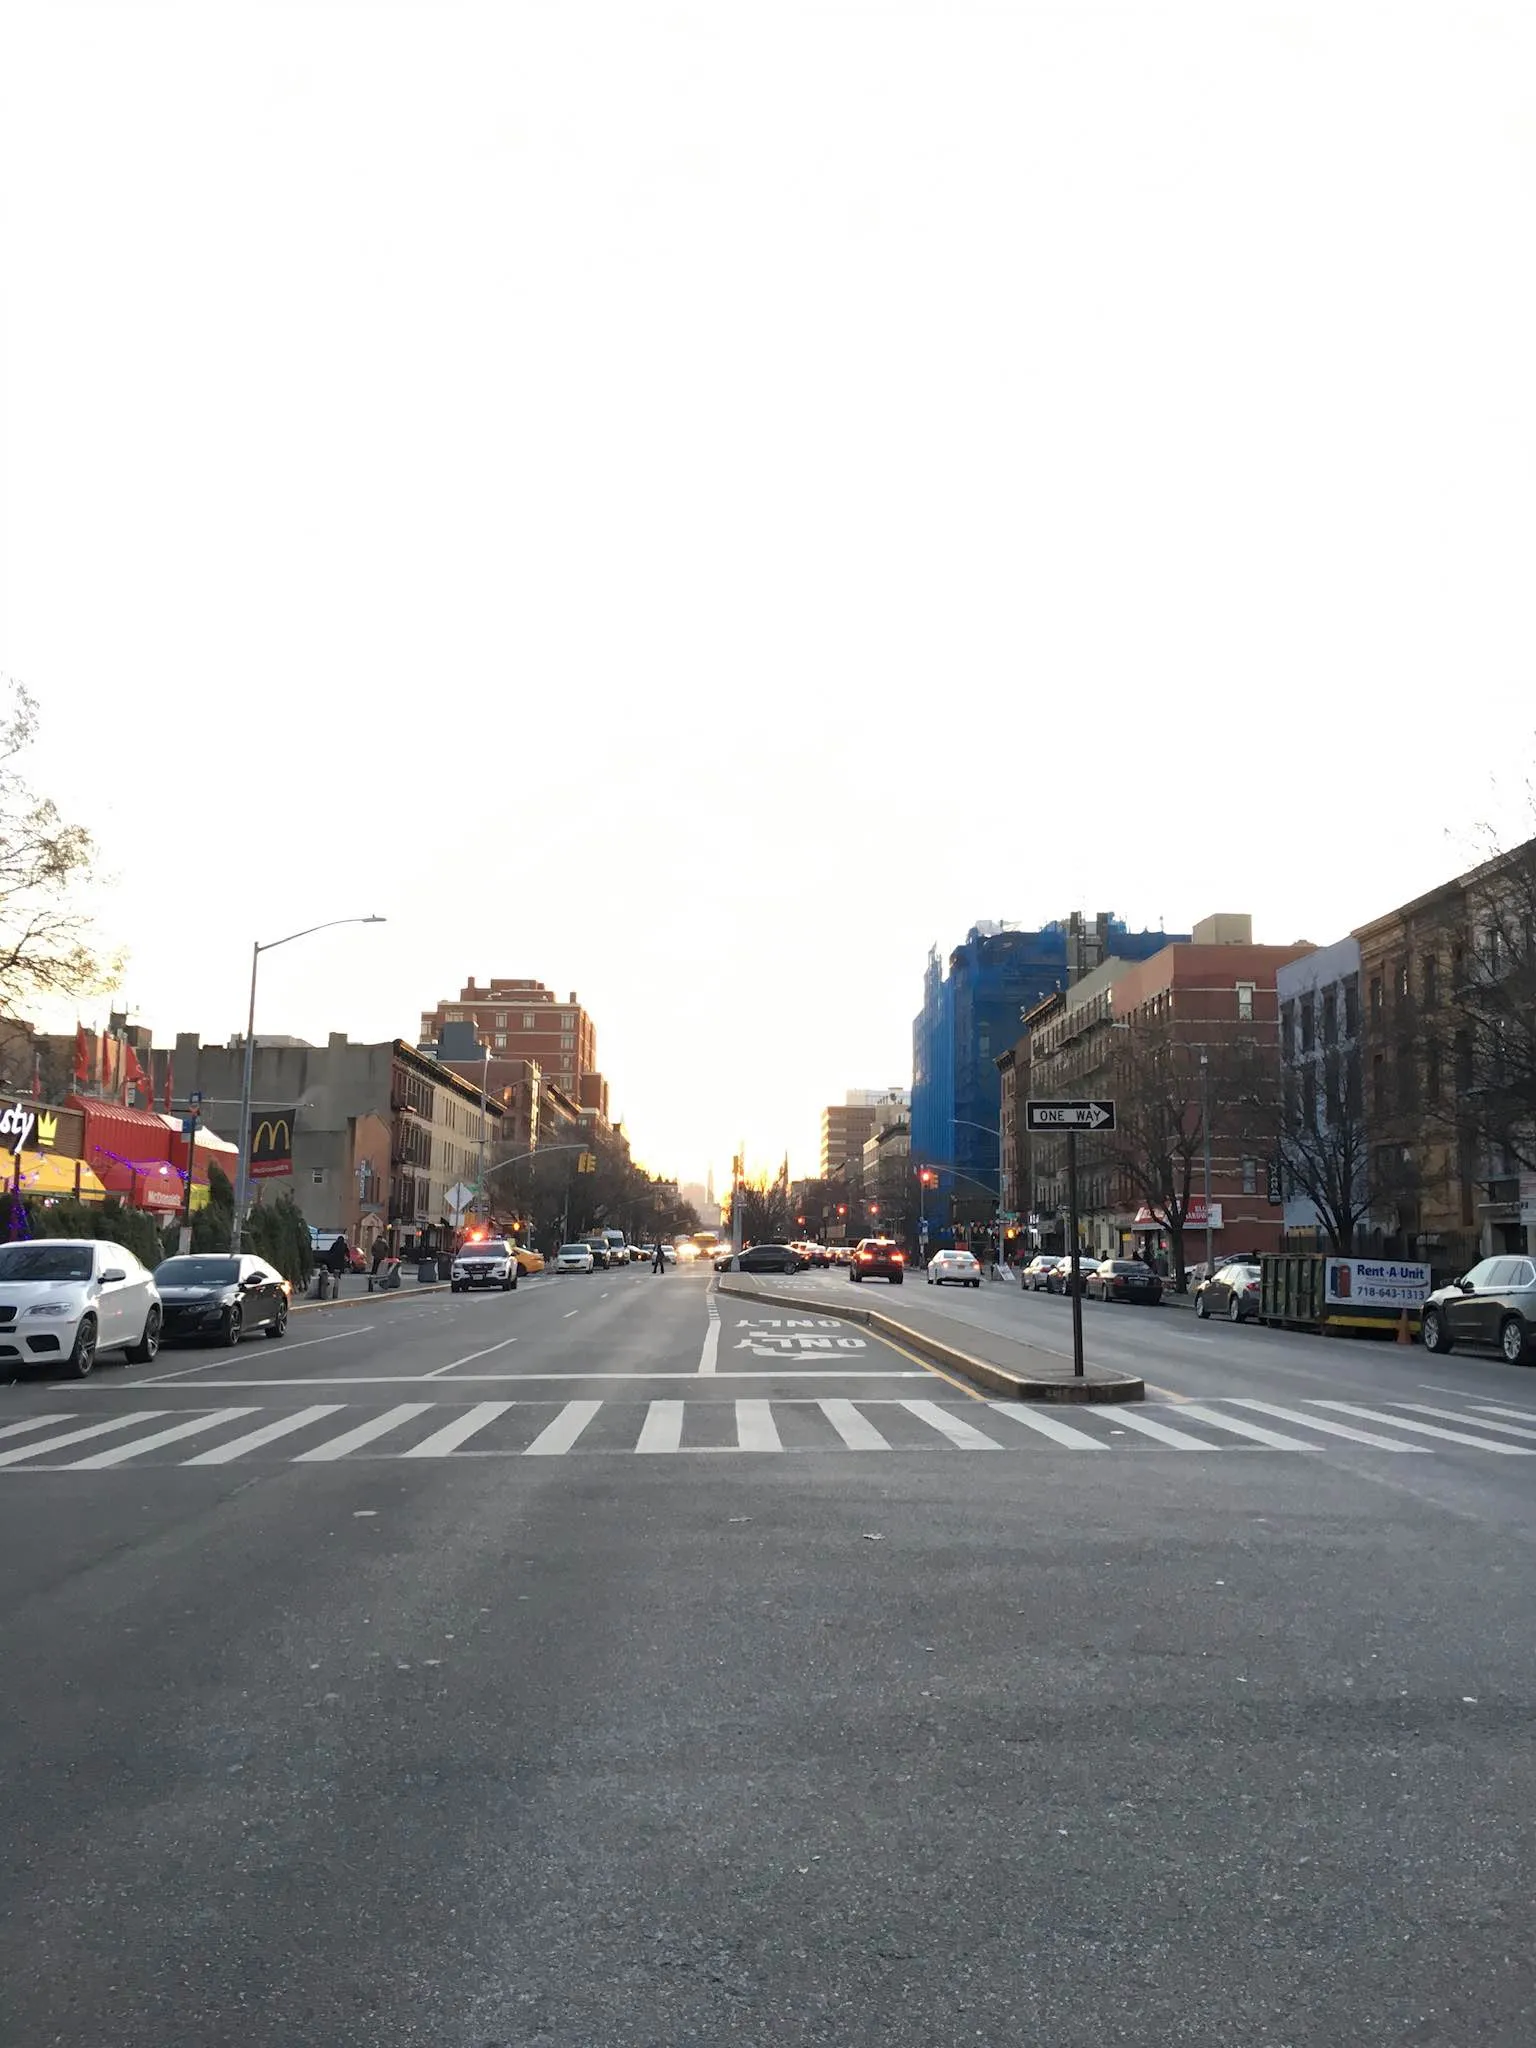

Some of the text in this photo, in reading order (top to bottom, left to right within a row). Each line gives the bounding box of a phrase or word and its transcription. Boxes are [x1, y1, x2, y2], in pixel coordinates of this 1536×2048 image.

[1040, 1110, 1101, 1121] ONE WAY
[0, 1103, 35, 1155] sty
[1357, 1286, 1425, 1300] 718-643-1313
[735, 1319, 841, 1328] ONLY
[733, 1338, 867, 1349] ONLY
